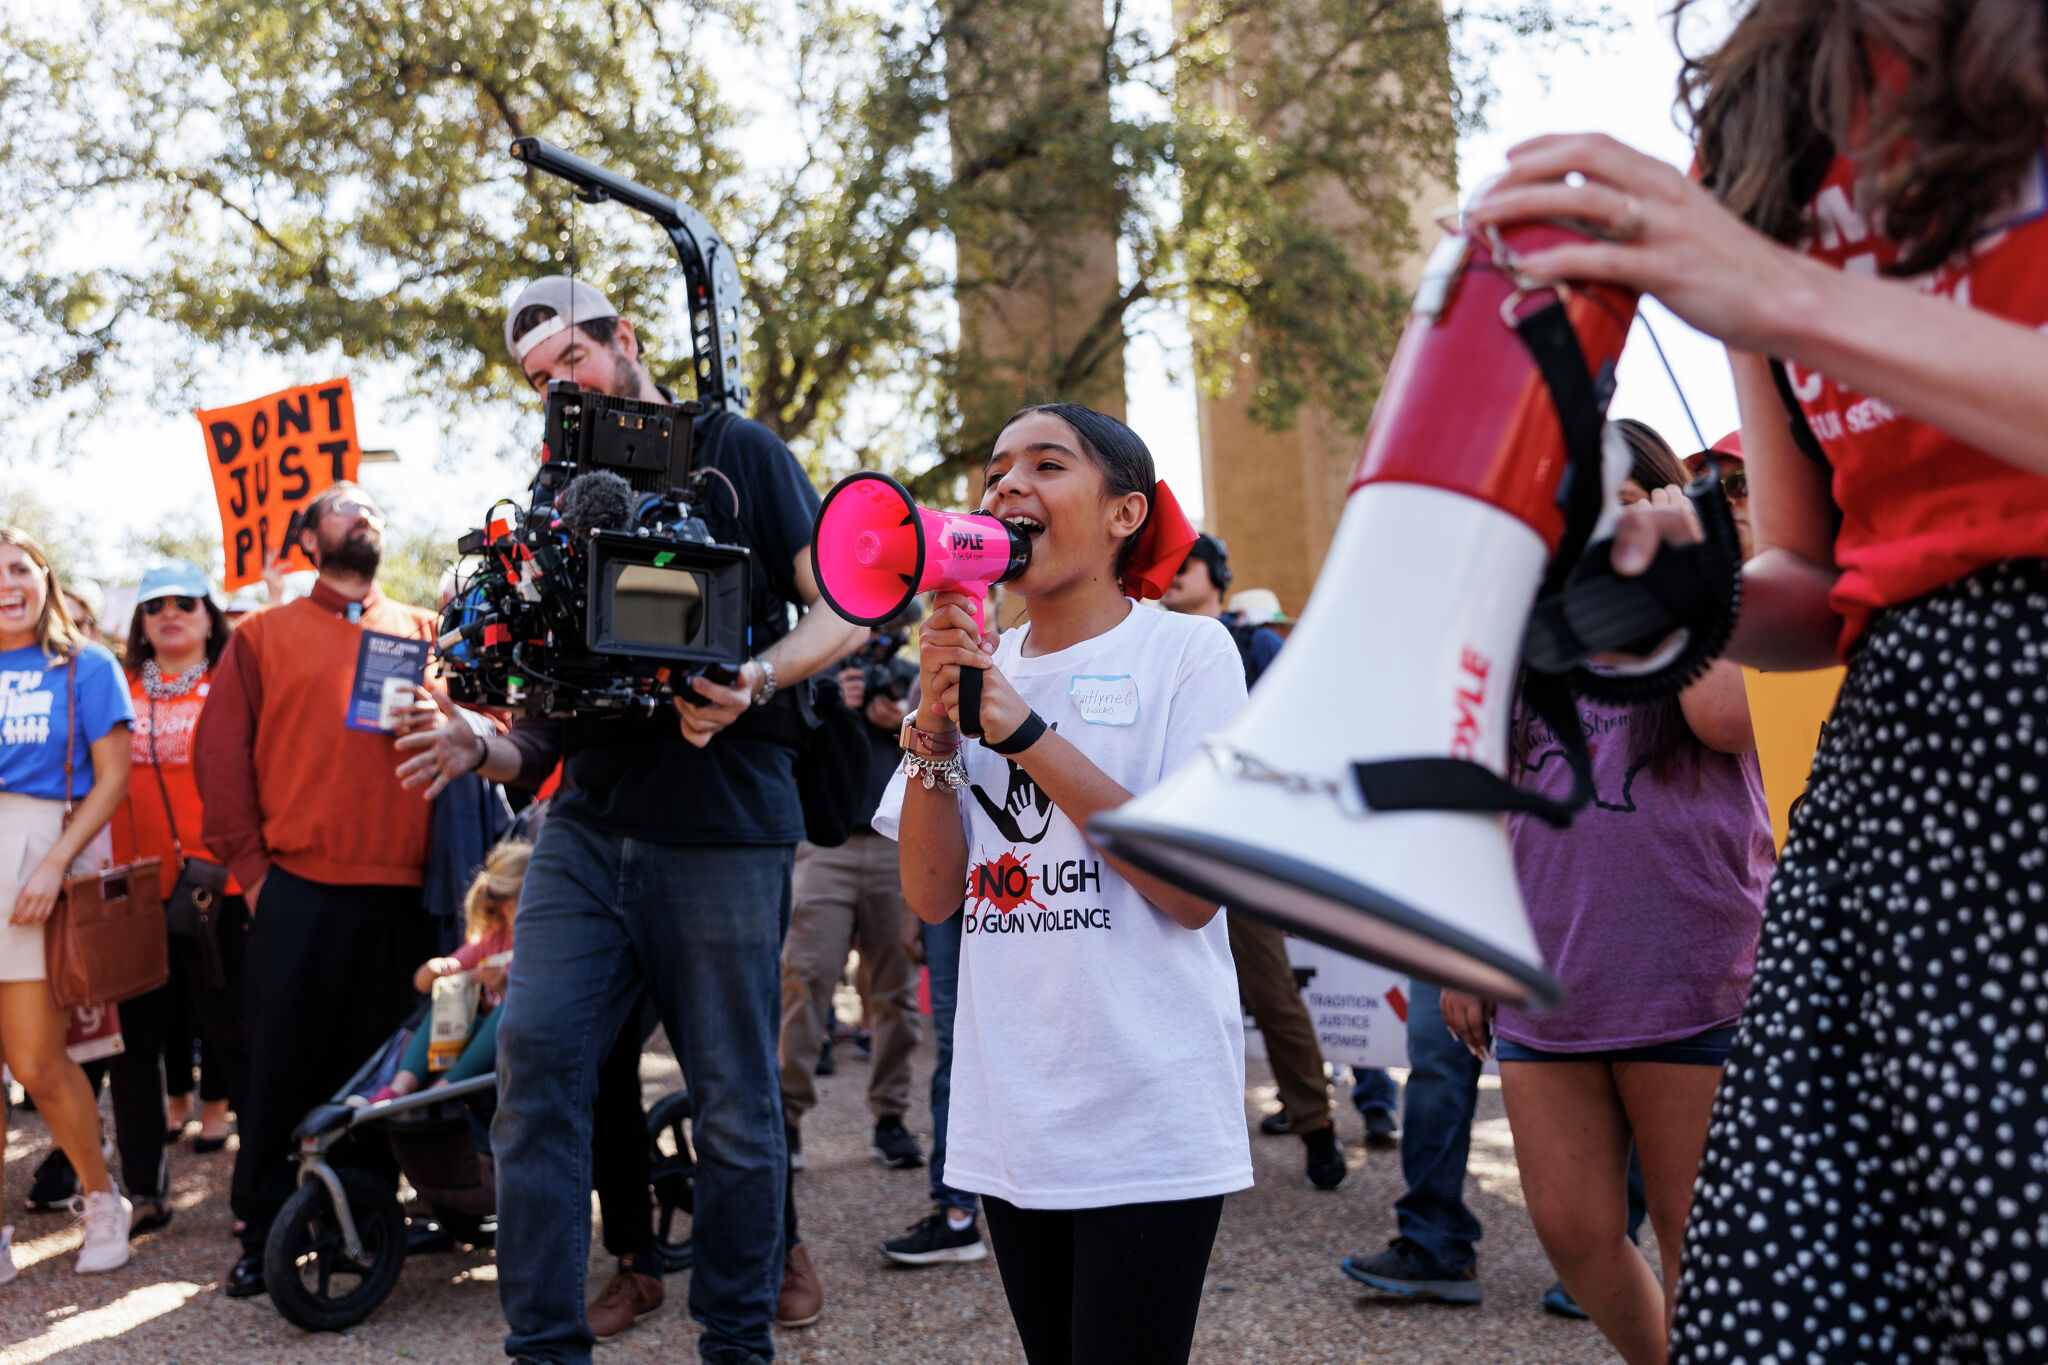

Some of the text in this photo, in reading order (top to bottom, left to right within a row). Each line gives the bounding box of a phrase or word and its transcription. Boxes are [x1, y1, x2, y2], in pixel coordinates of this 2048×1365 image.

[209, 387, 343, 464] DONT
[230, 440, 349, 518] JUST
[951, 532, 984, 550] PYLE
[1582, 709, 1629, 738] Stron
[966, 860, 1101, 898] NO UGH
[982, 911, 1025, 934] GUN
[1027, 908, 1112, 933] VIOLENCE
[1309, 992, 1379, 1009] TRADITION
[1319, 1013, 1370, 1029] JUSTICE
[1320, 1031, 1369, 1048] POWER
